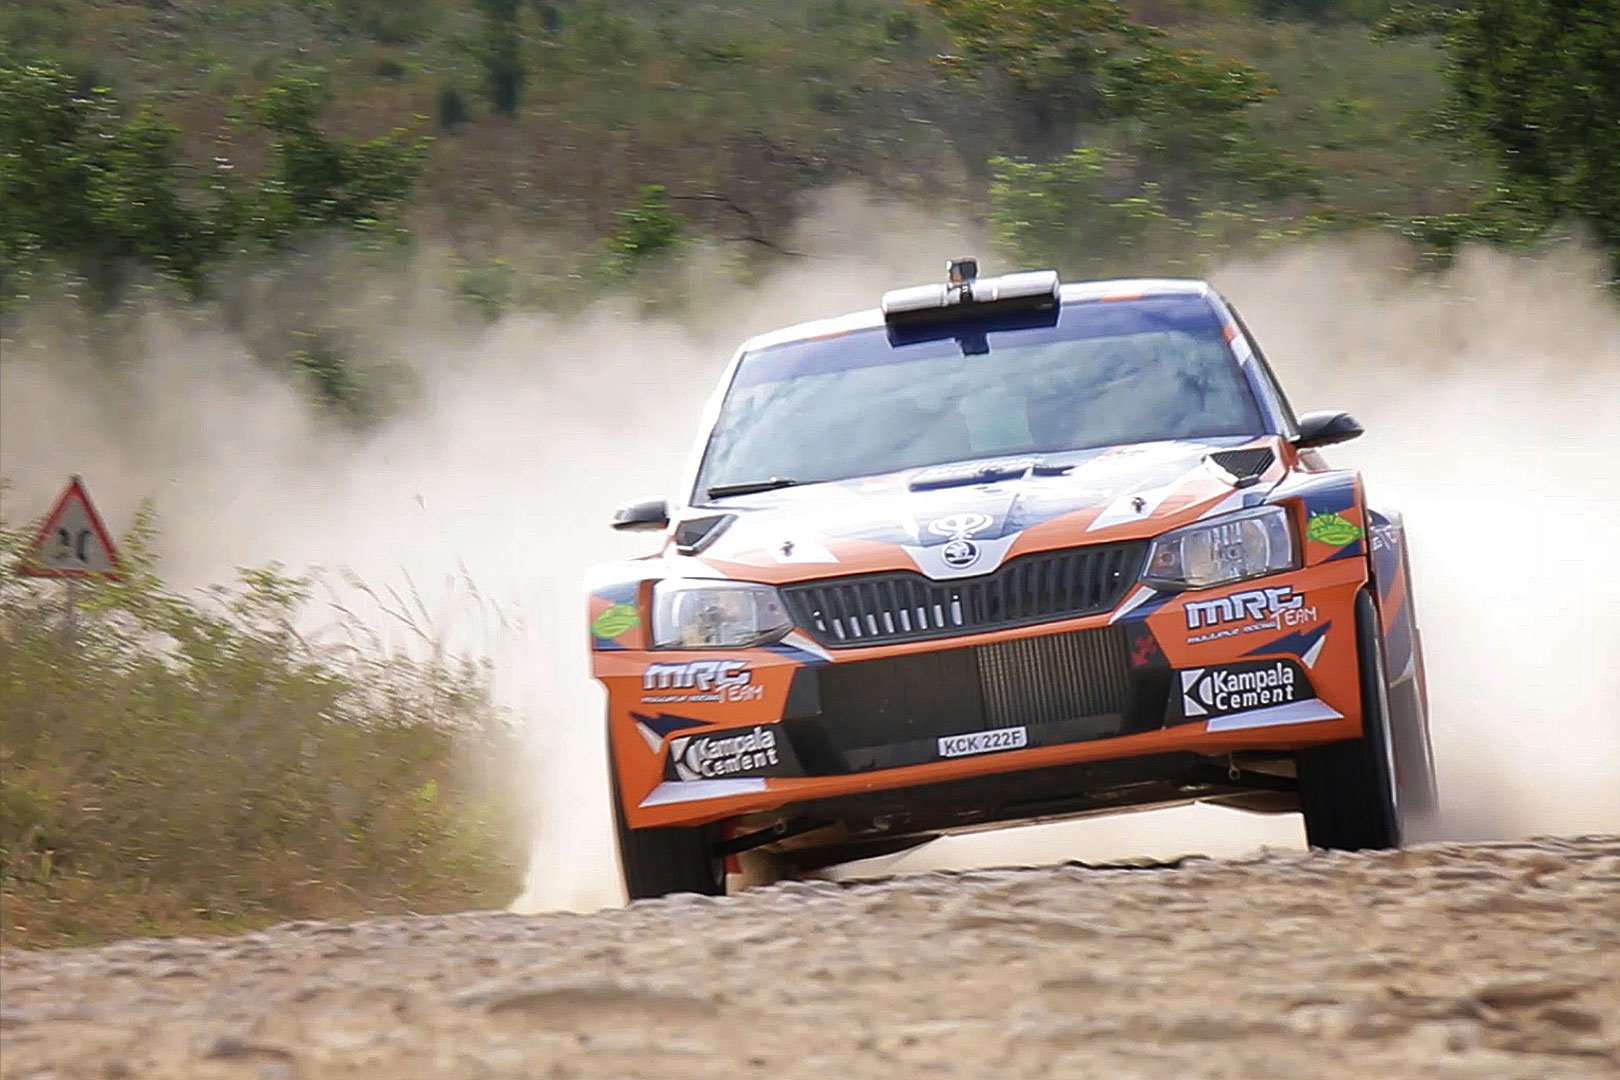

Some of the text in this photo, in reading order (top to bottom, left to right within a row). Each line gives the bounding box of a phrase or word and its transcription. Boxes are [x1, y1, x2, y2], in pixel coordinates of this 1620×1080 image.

[1271, 606, 1317, 630] TEAM
[1212, 662, 1294, 694] Kampala
[714, 683, 764, 704] TEAM
[1215, 685, 1294, 710] Cement
[697, 726, 776, 760] Kampala
[944, 731, 1020, 754] KCK 222F
[701, 748, 780, 777] Cement
